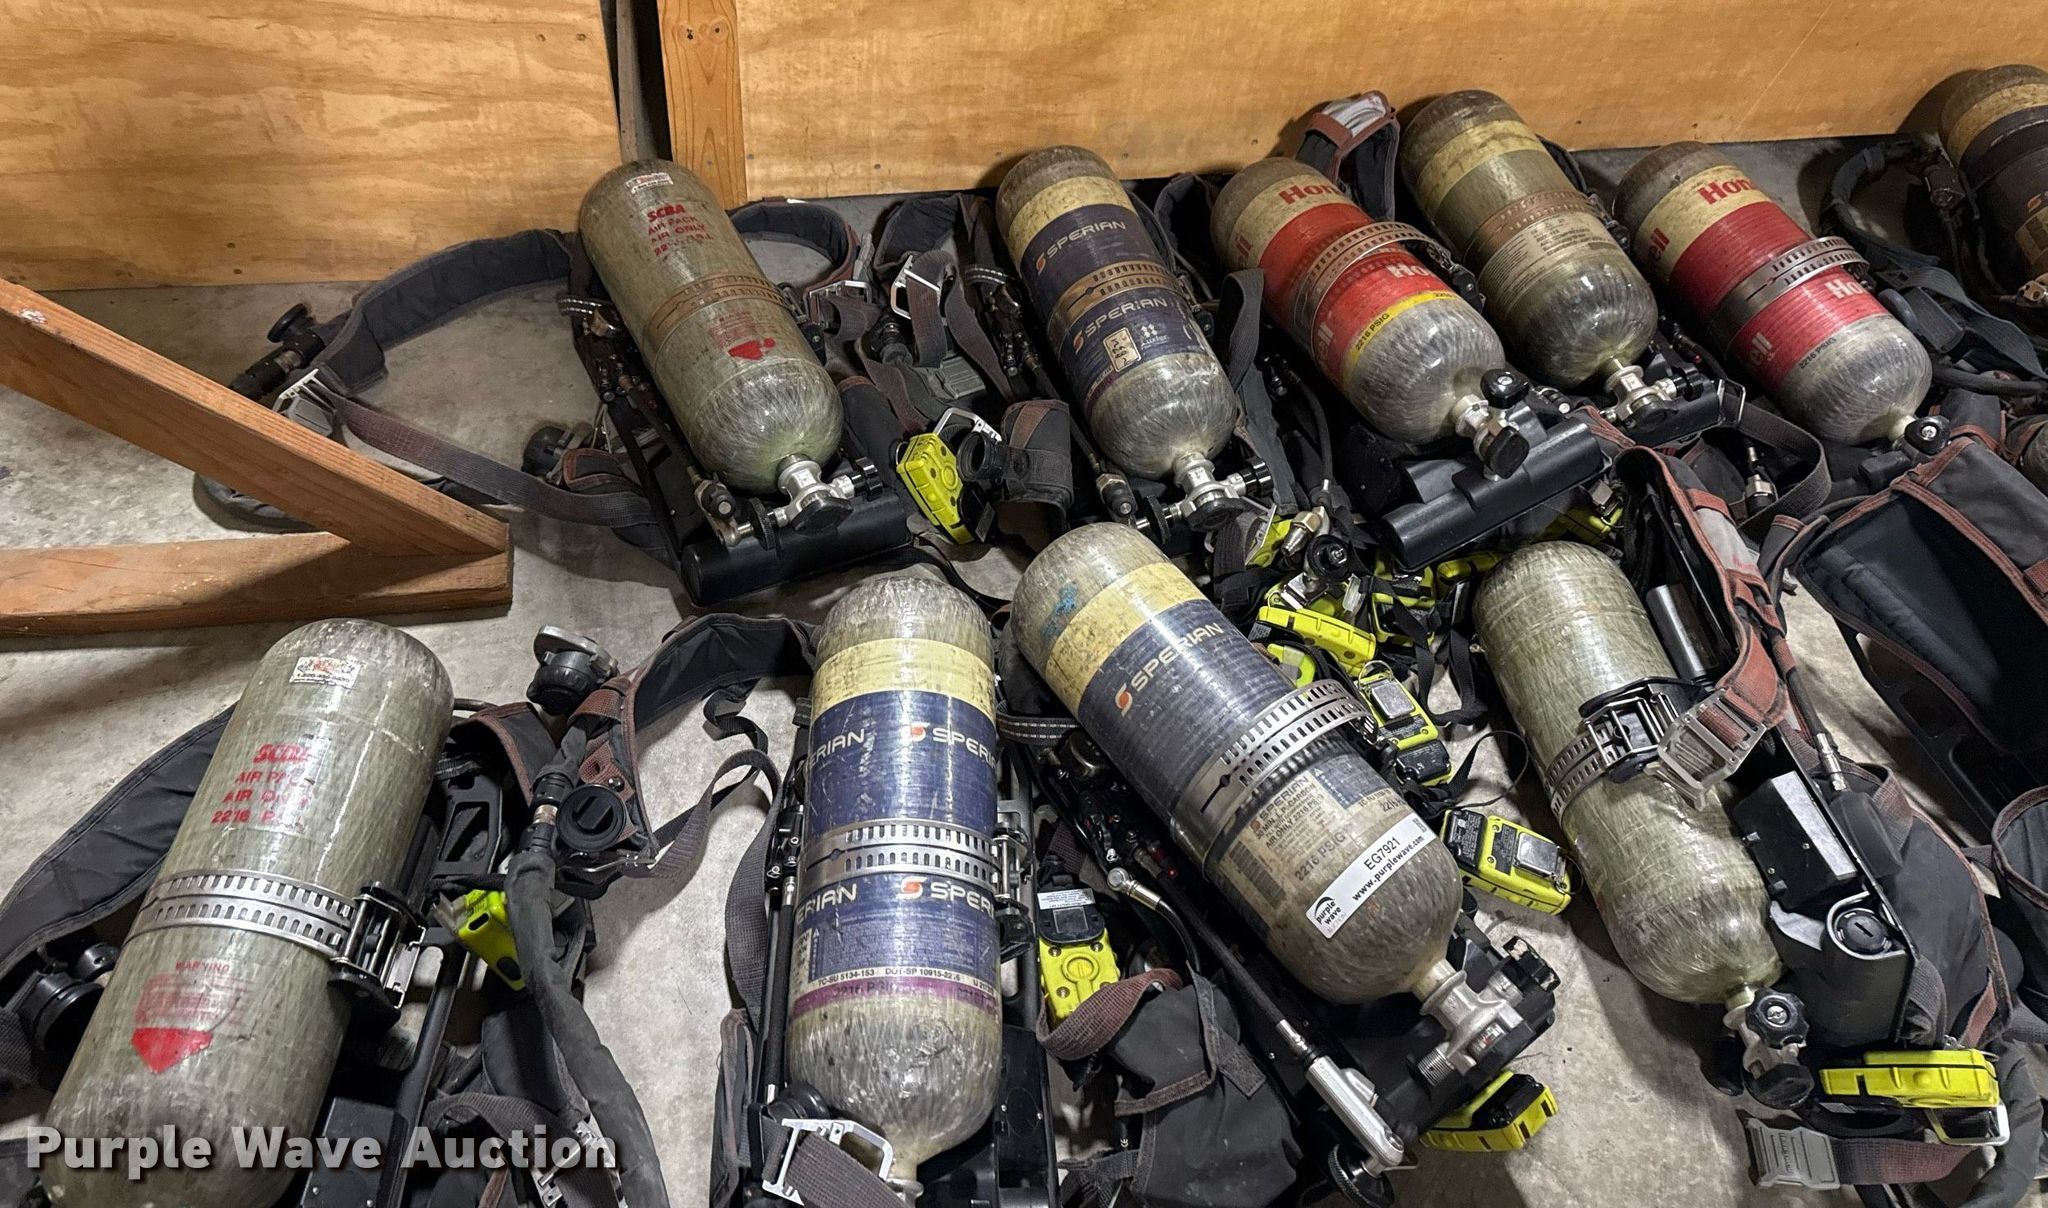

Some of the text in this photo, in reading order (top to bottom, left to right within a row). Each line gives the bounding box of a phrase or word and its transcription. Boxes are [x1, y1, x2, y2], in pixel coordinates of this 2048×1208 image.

[675, 223, 705, 234] ONLY
[1046, 220, 1127, 259] SPERIAN
[1084, 296, 1168, 338] SPERIAN
[1355, 313, 1390, 351] 2216 PSIG
[1130, 622, 1225, 692] SPERIAN
[234, 770, 263, 785] AIR
[222, 788, 253, 804] AIR
[1259, 775, 1310, 821] SPERIAN
[211, 809, 251, 825] 2216
[1266, 834, 1277, 849] AIR
[1276, 817, 1293, 839] ONLY
[1295, 854, 1320, 882] 2216
[1317, 830, 1347, 858] PSIG
[1352, 834, 1425, 901] www.purplewave.com
[1363, 836, 1401, 871] EG7921
[1316, 900, 1337, 925] purple
[1324, 906, 1342, 925] wave
[840, 968, 875, 981] 5134-153
